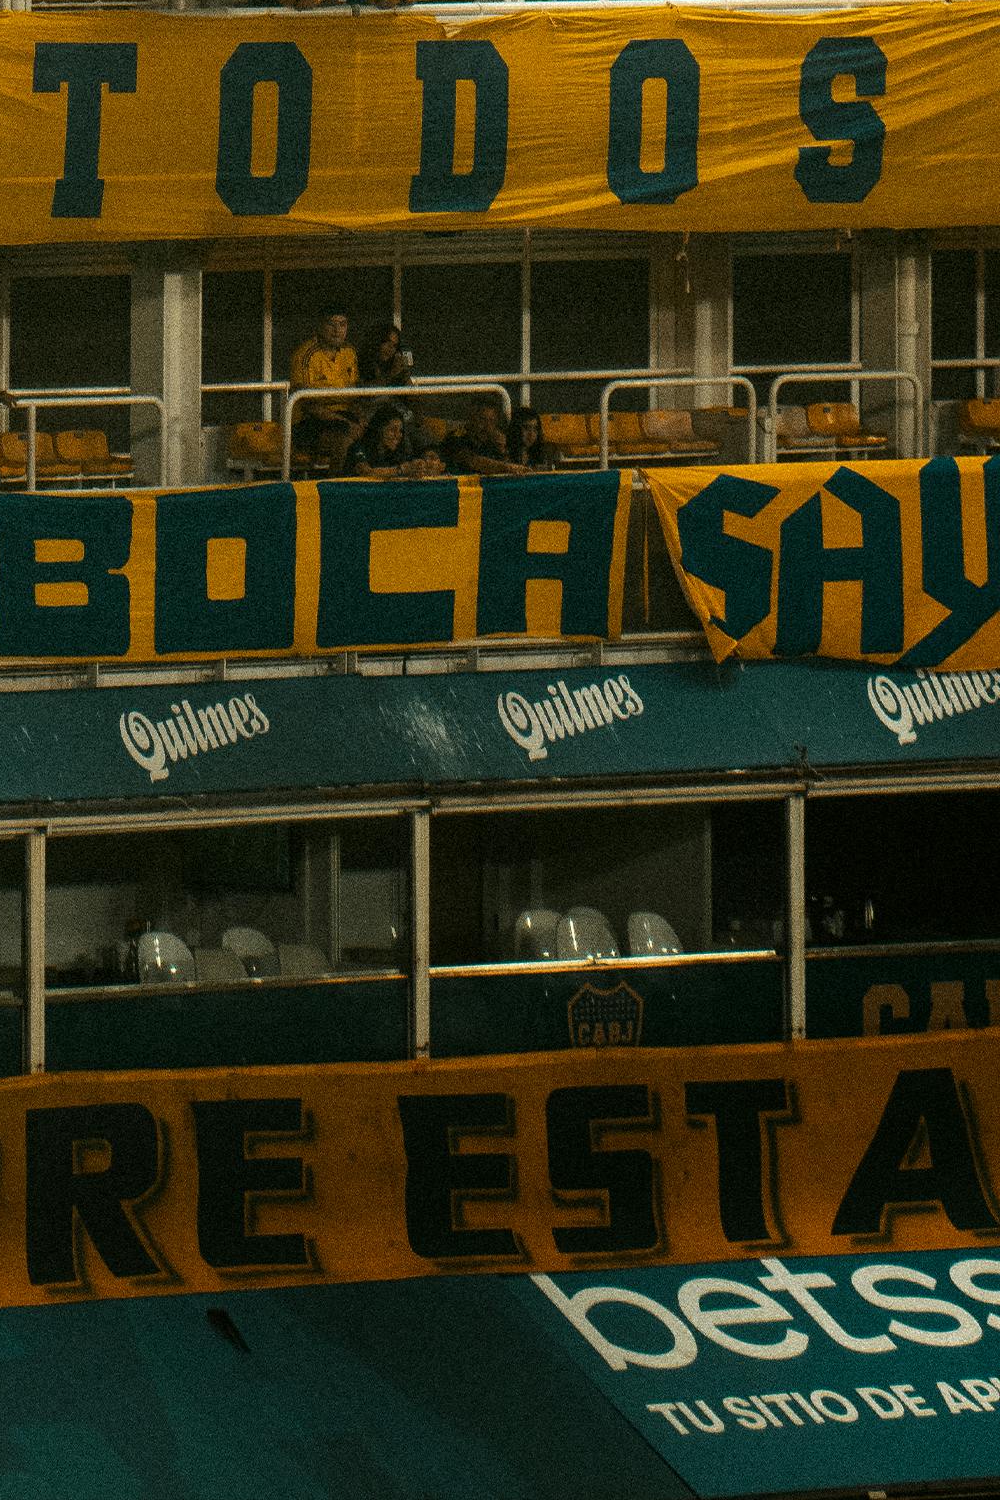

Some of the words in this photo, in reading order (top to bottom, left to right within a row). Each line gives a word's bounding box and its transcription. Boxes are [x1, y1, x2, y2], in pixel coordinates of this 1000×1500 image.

[32, 35, 889, 218] TODOS
[119, 692, 271, 782] Quilmes
[498, 674, 644, 761] Quilmes
[396, 1067, 1000, 1264] ESTA
[647, 1399, 726, 1436] TU
[724, 1389, 860, 1431] SITIO
[856, 1384, 938, 1419] DE
[936, 1376, 1000, 1414] AP
